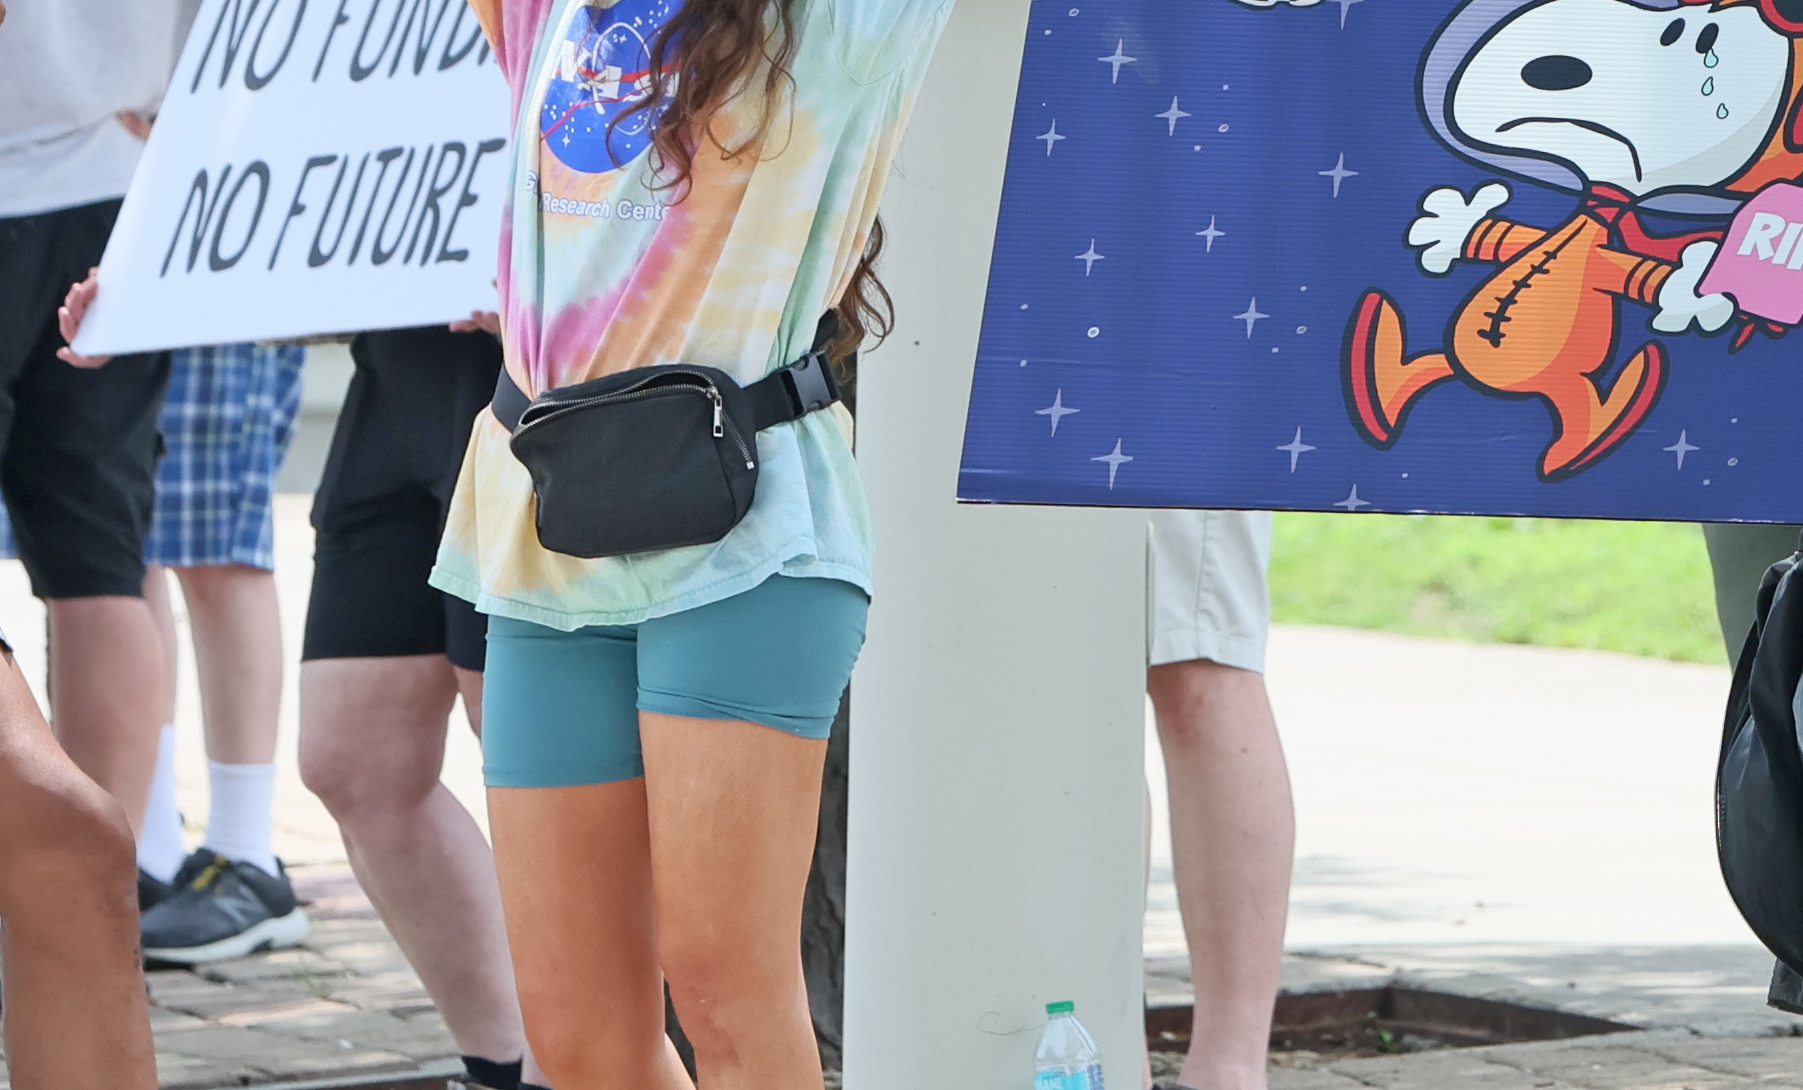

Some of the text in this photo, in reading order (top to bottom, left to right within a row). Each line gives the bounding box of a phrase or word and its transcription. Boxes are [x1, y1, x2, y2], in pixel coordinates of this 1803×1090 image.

[159, 136, 507, 279] NO FUTURE
[541, 191, 670, 221] Research Cent
